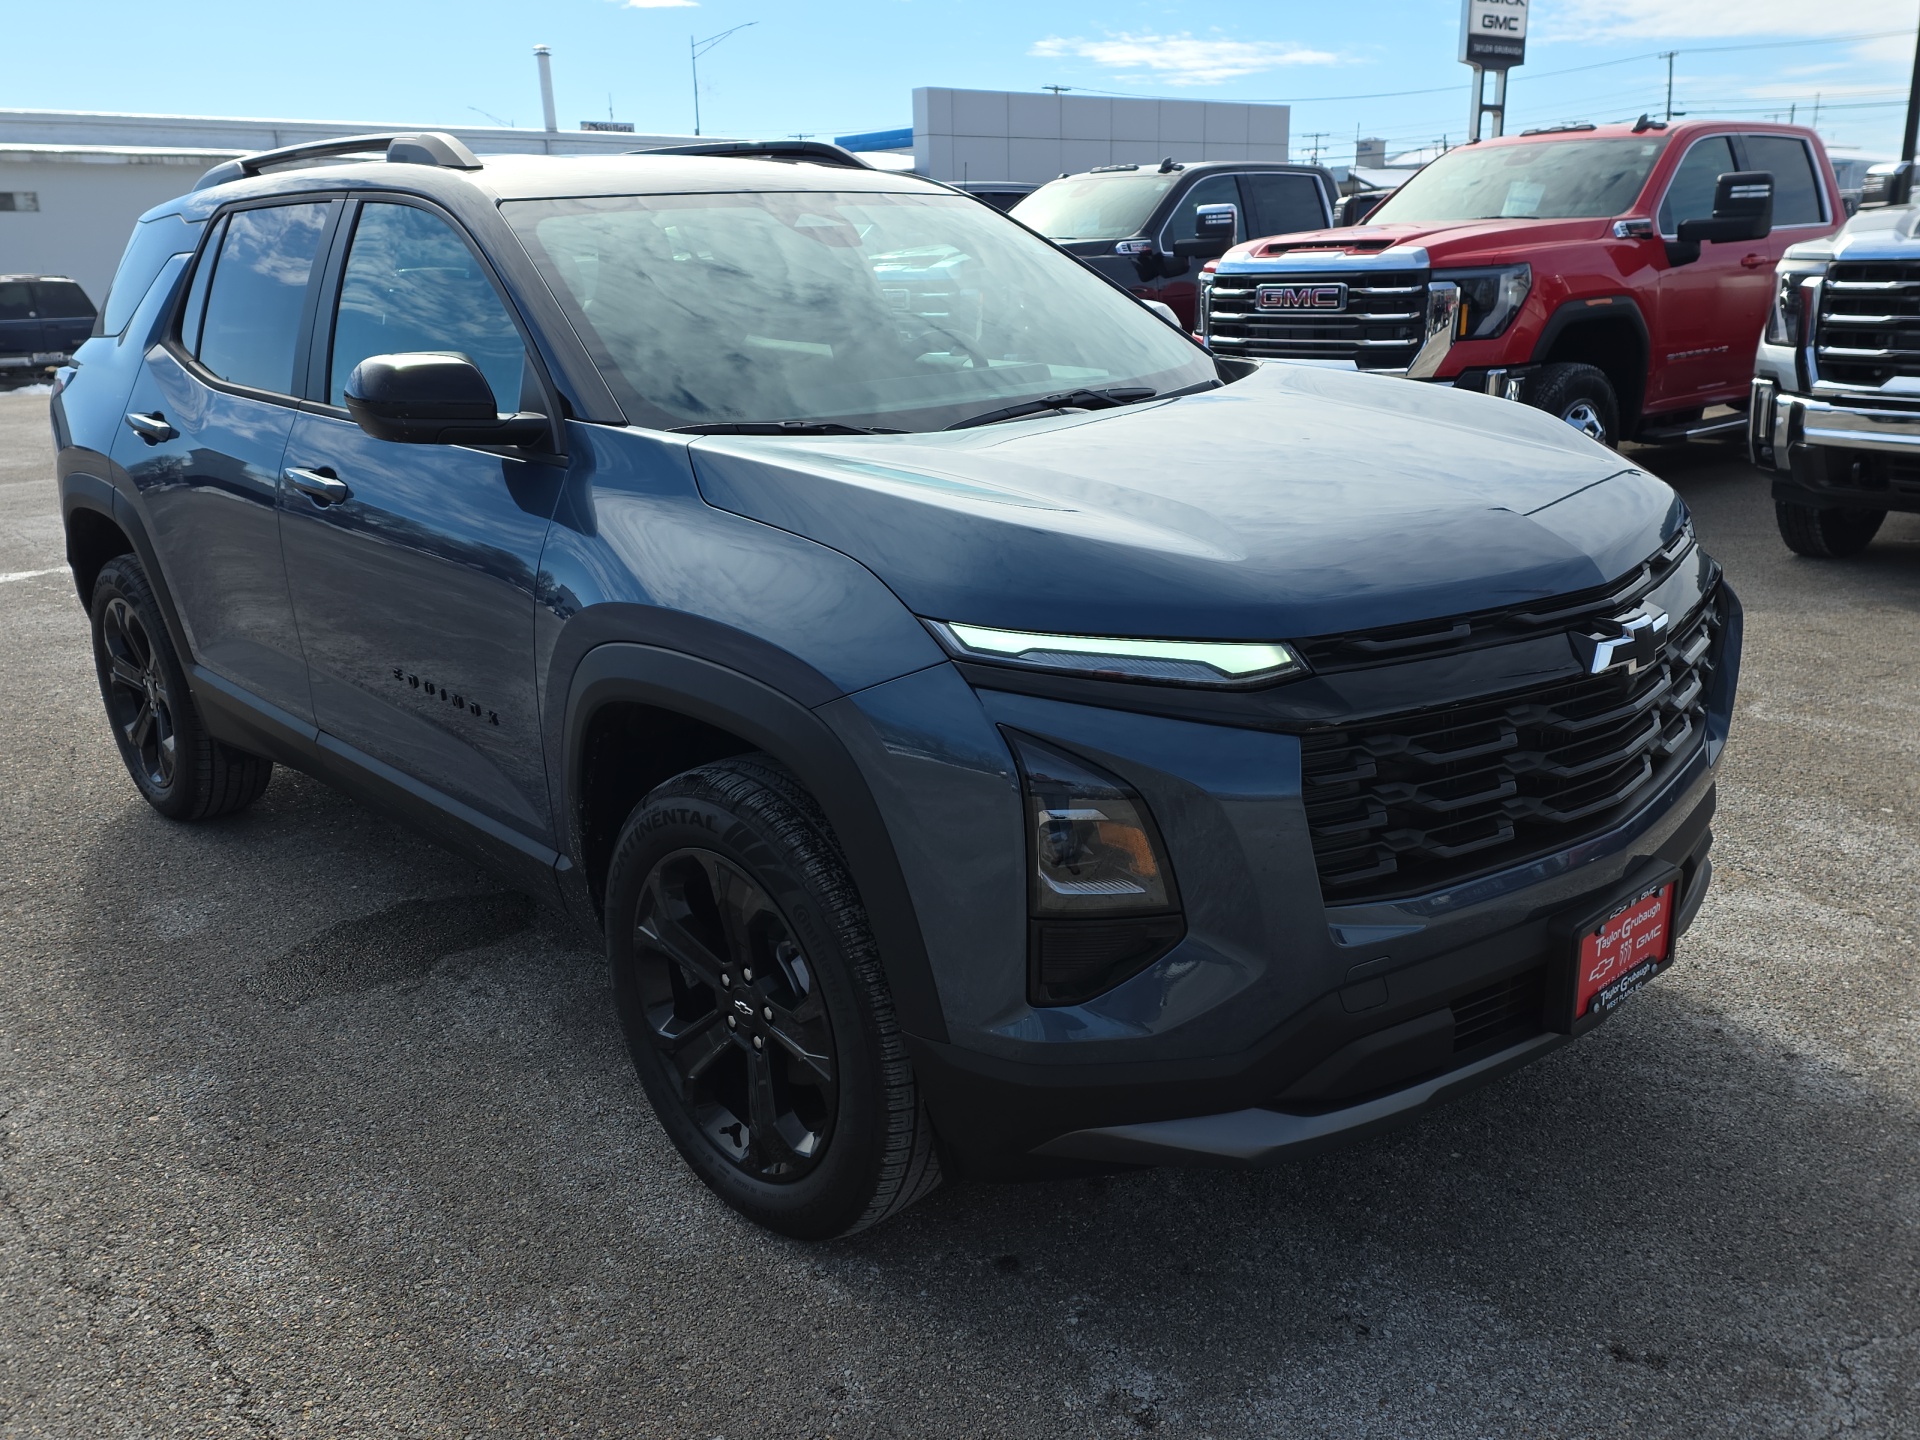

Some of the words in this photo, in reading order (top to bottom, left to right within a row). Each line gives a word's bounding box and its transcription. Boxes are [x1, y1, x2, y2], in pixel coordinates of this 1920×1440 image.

[1482, 14, 1519, 31] GMC
[1260, 288, 1339, 307] GMC
[393, 667, 500, 726] EQUINOX
[1640, 885, 1657, 900] GMC
[1596, 928, 1621, 957] Taylor
[1622, 902, 1661, 938] Grubaugh
[1636, 924, 1662, 949] GMC
